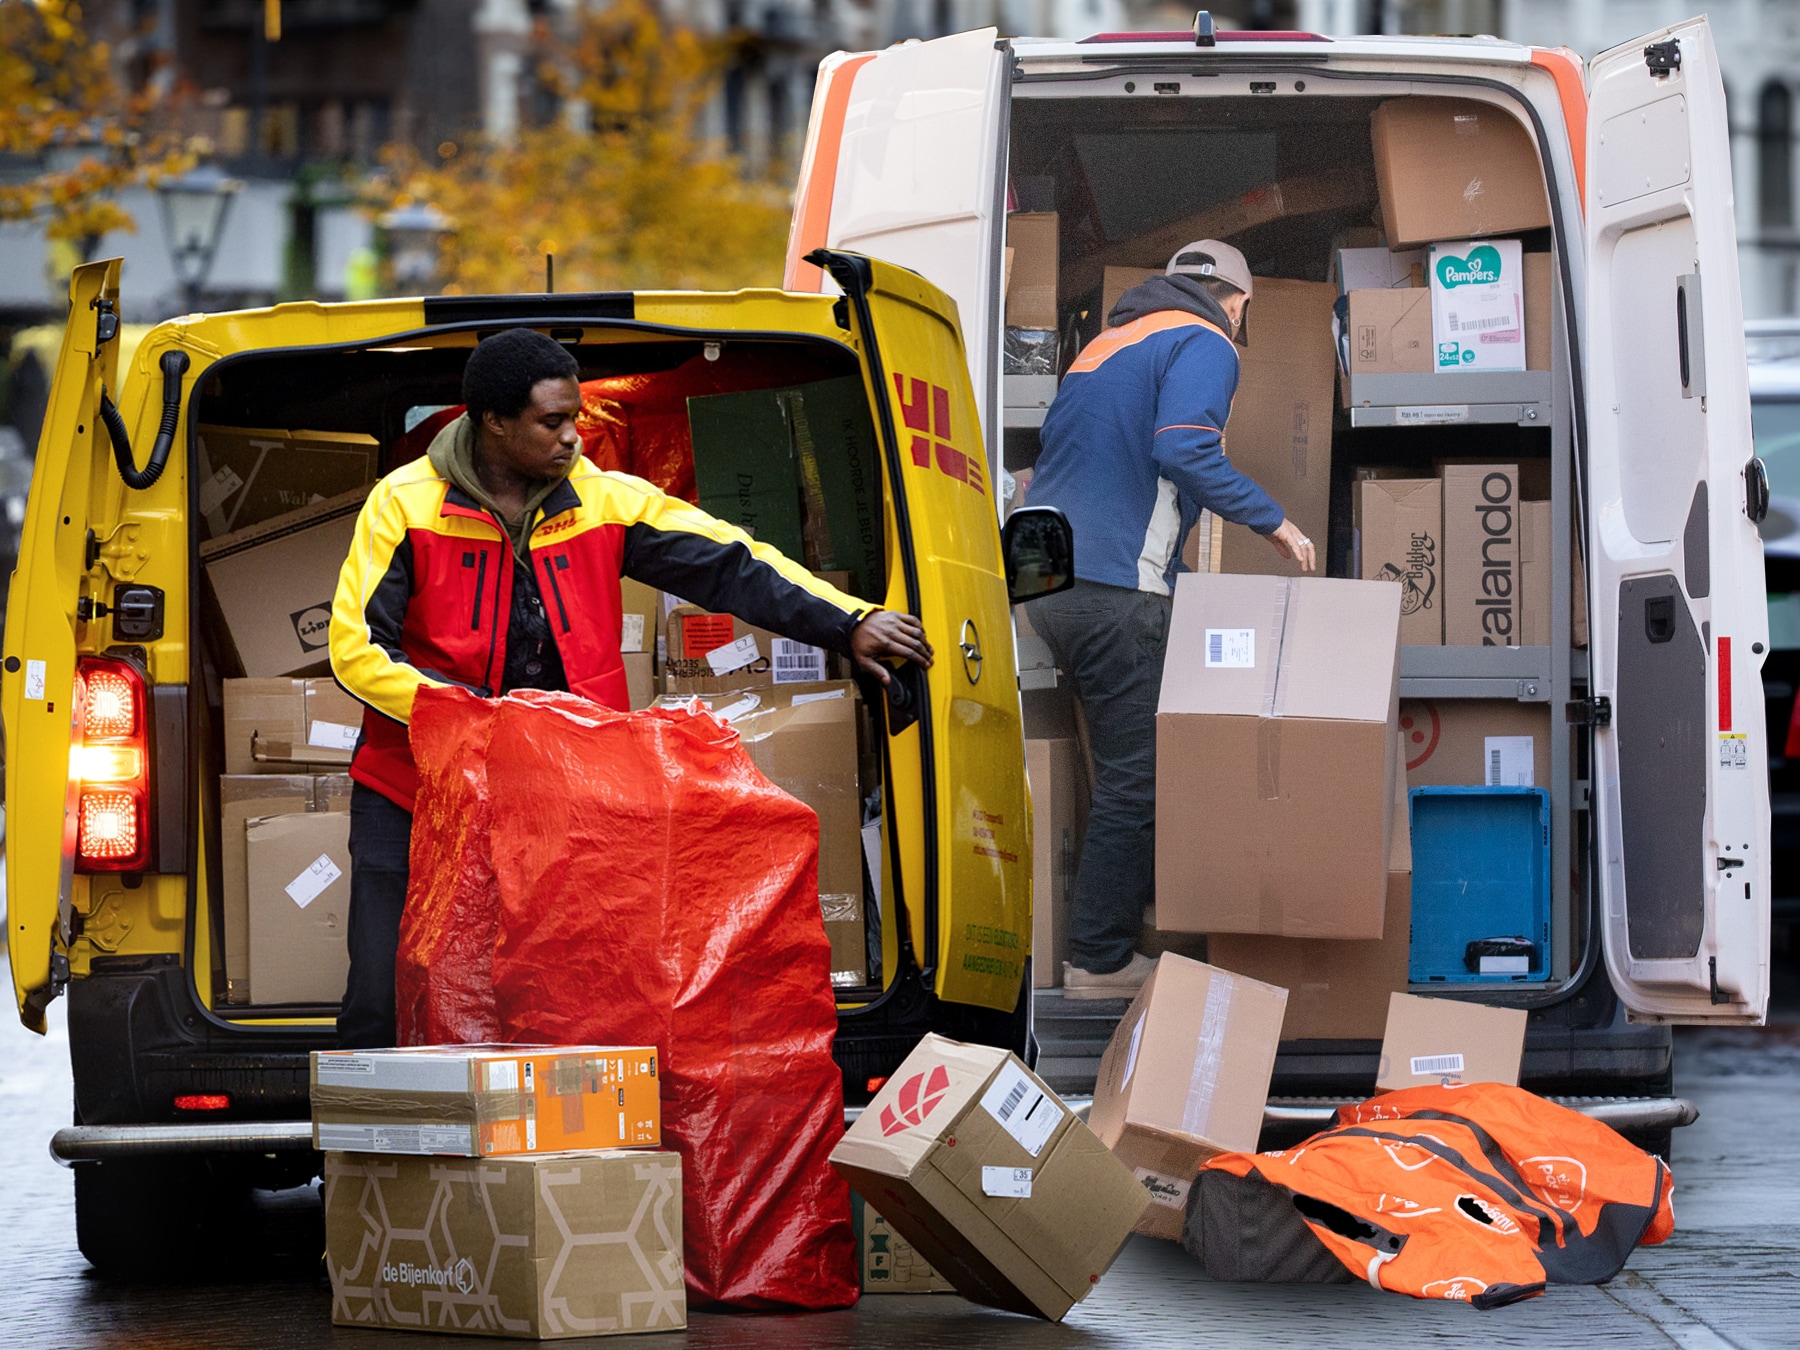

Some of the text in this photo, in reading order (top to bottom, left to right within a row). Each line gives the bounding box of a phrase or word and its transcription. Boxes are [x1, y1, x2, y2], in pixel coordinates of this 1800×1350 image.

[1445, 266, 1495, 283] Pampers
[842, 418, 852, 432] IK
[893, 372, 968, 484] HL
[844, 435, 866, 495] HOORDE
[856, 500, 868, 515] JE
[541, 517, 577, 536] DHL
[1406, 532, 1423, 578] Bakker
[1019, 1170, 1029, 1179] 35
[875, 1255, 884, 1267] F
[382, 1262, 453, 1288] de Bijenkorf
